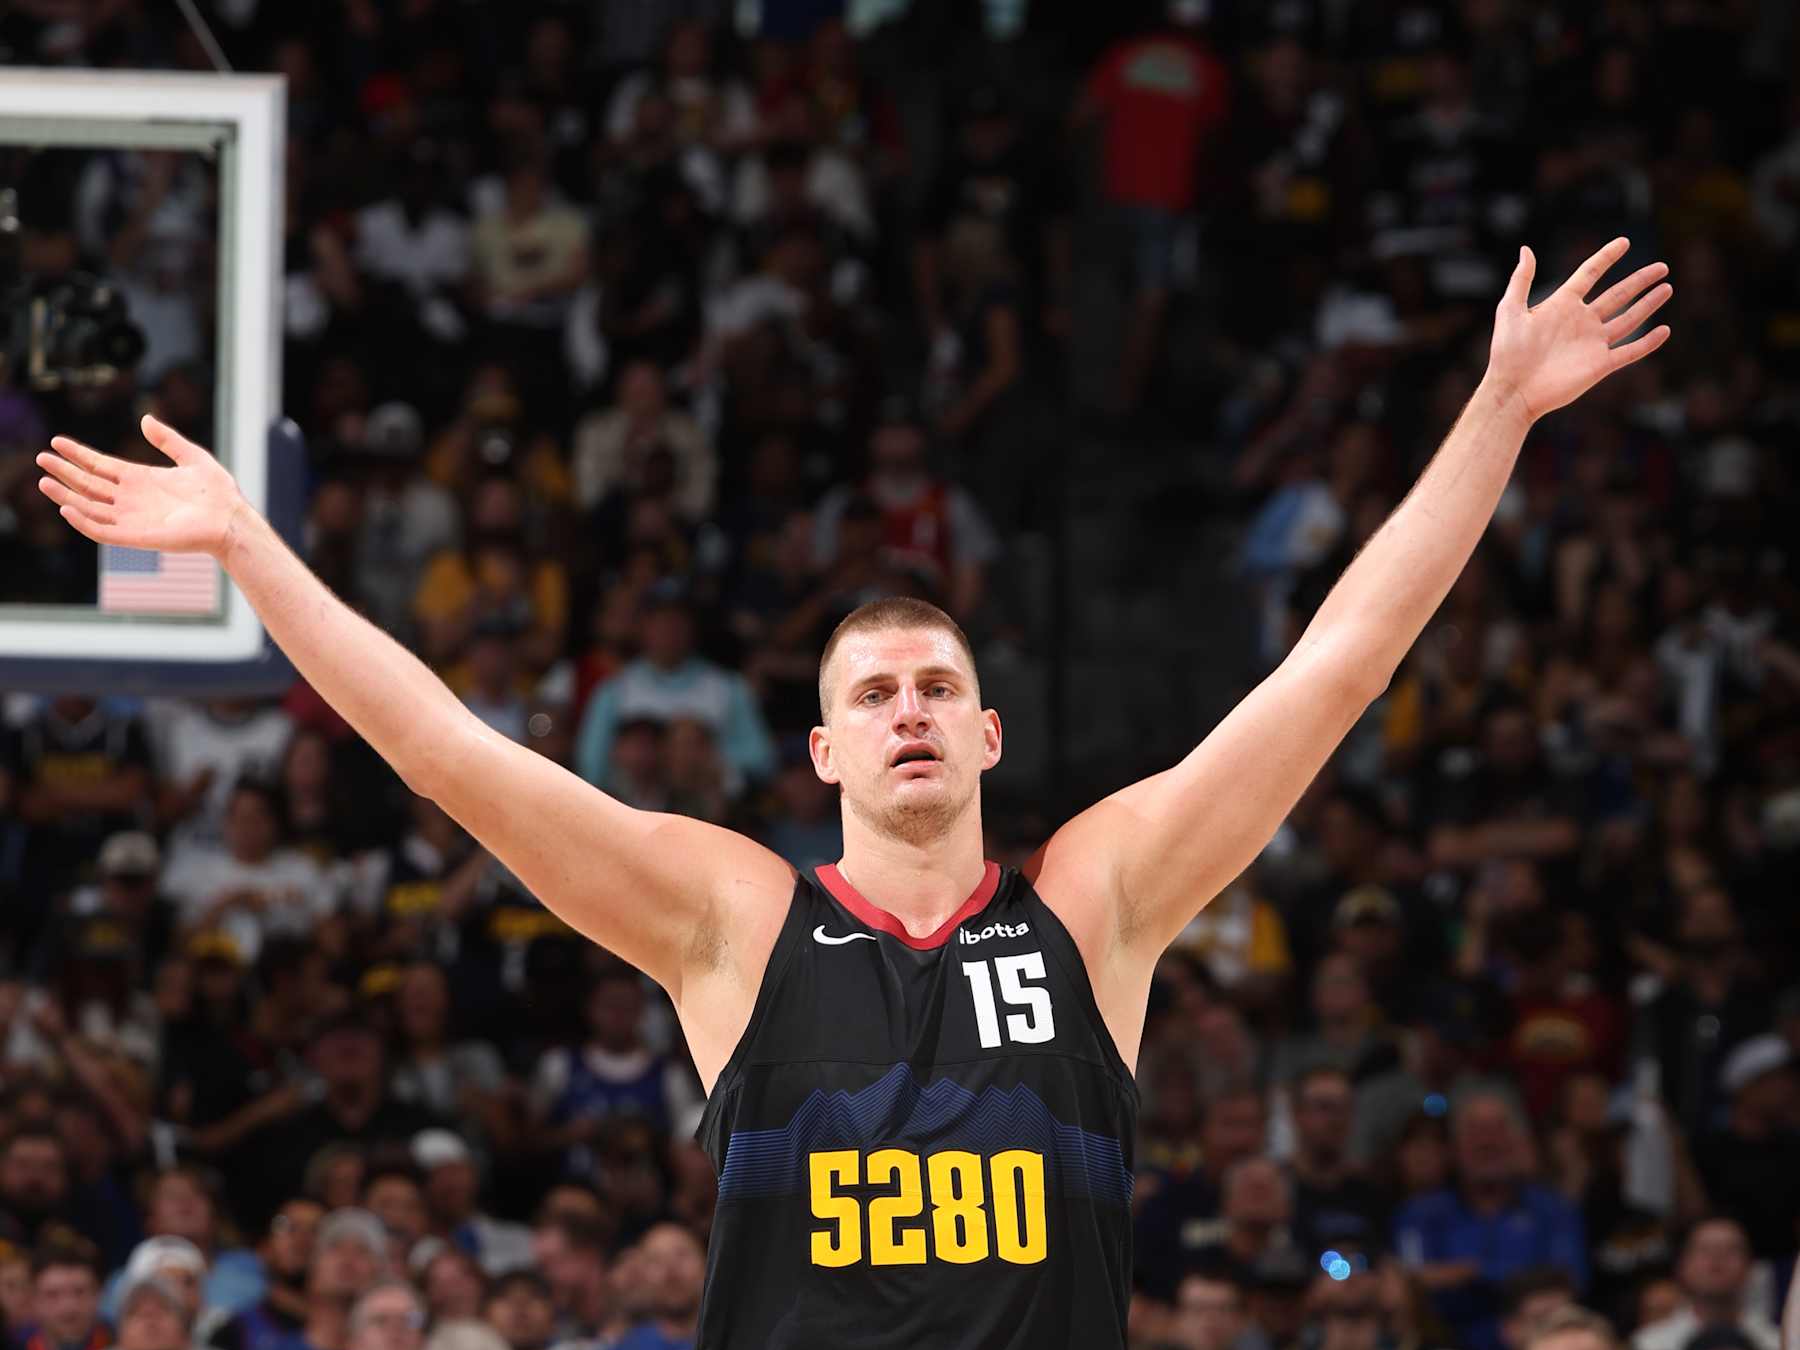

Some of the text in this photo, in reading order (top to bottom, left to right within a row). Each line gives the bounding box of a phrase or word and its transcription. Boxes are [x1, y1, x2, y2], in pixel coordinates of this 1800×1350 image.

[959, 922, 1030, 945] ibotta
[961, 951, 1056, 1049] 15
[808, 1149, 1048, 1268] 5280
